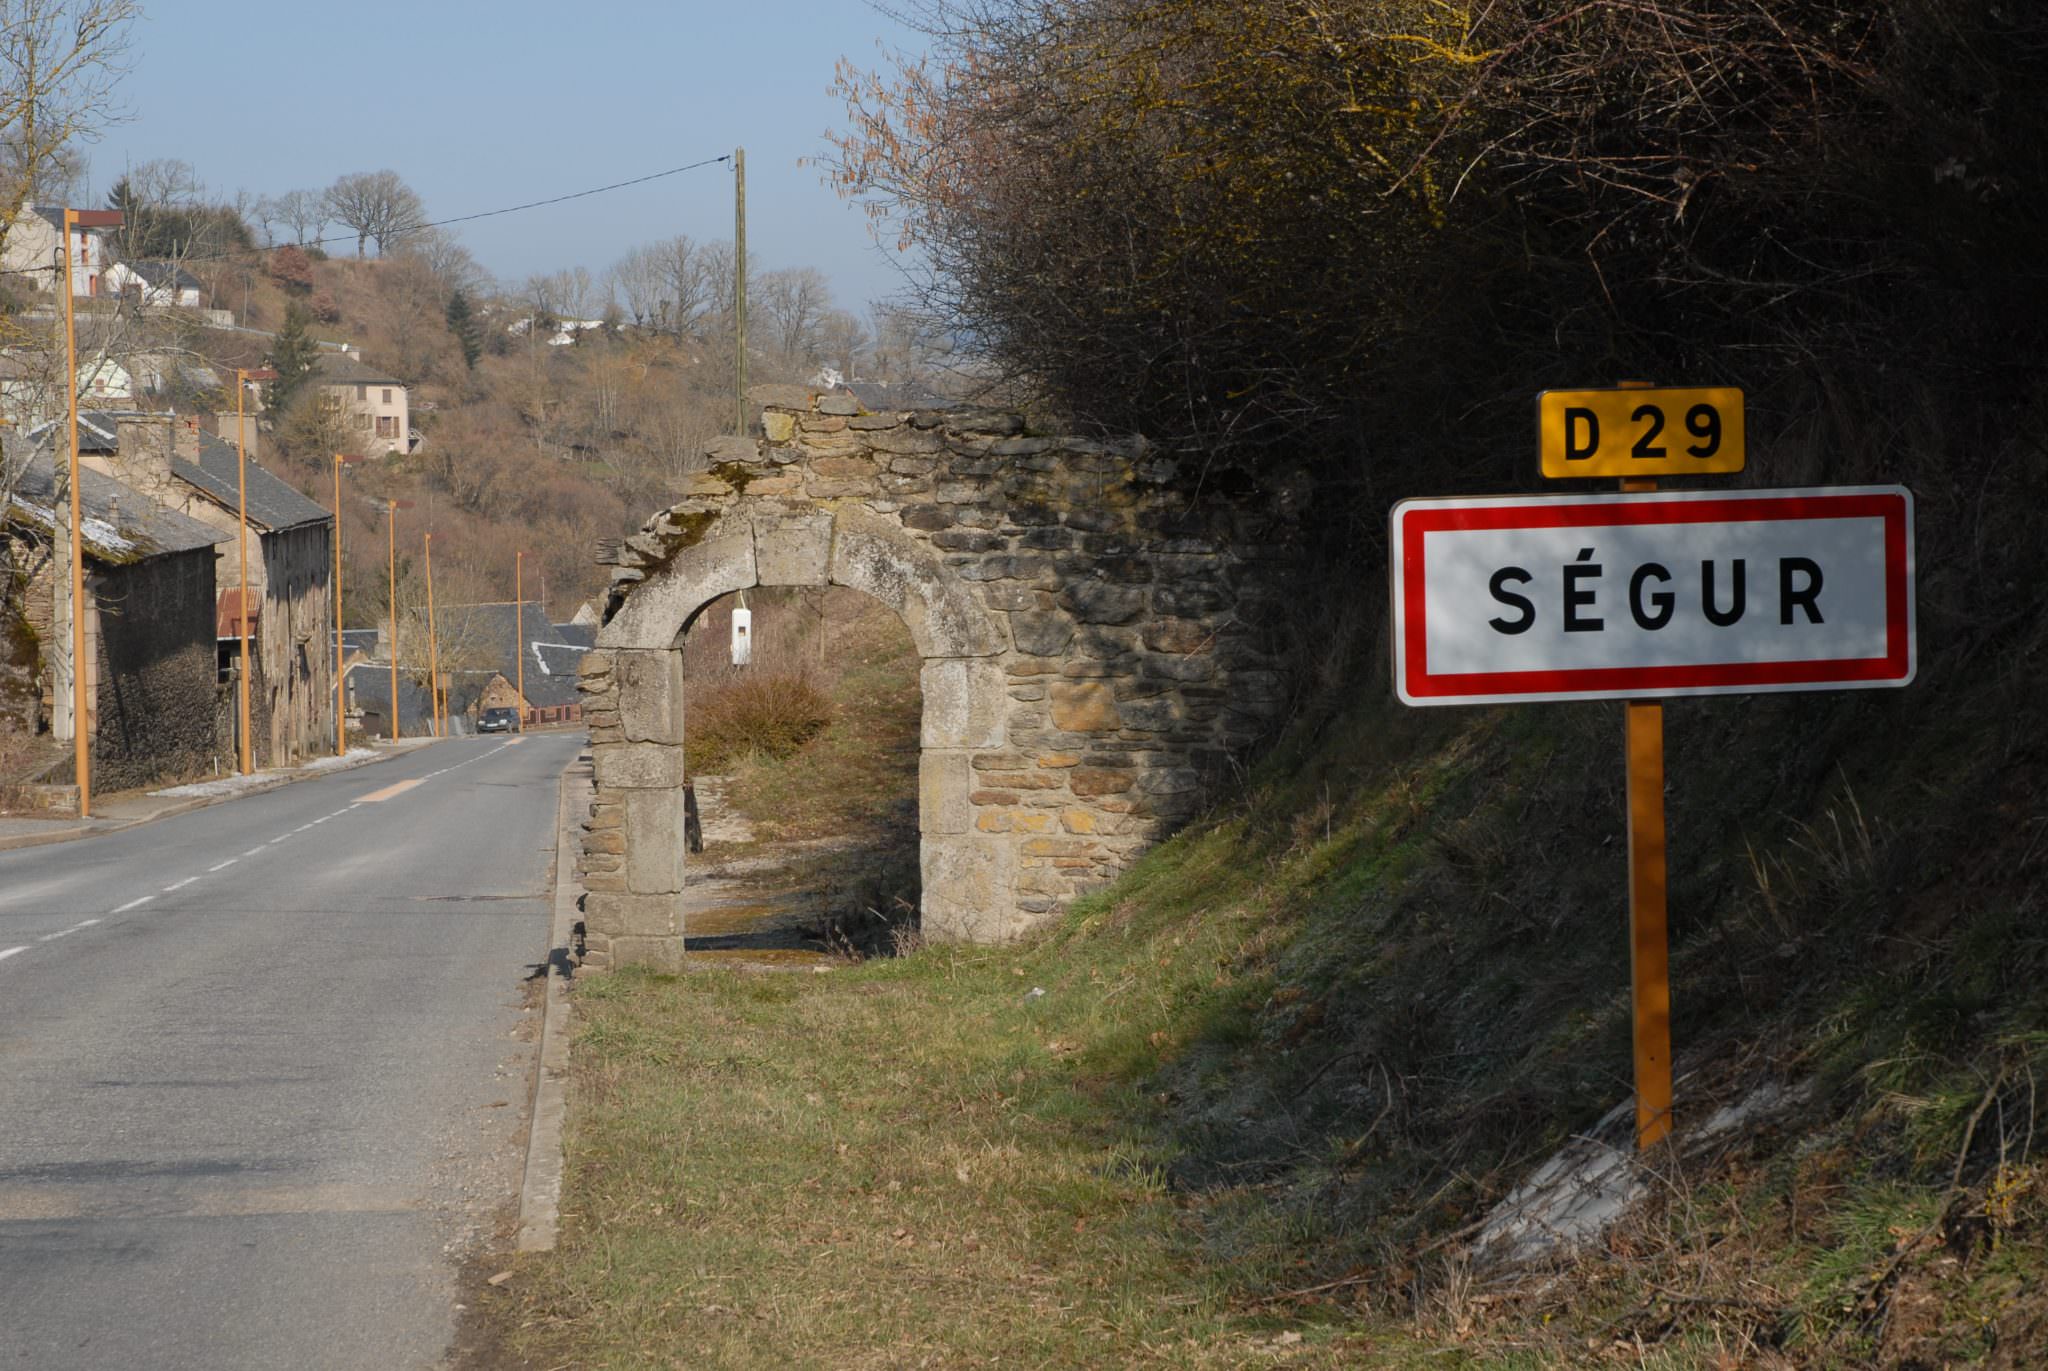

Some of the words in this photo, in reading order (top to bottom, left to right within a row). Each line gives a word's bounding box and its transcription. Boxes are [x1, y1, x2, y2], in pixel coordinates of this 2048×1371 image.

[1564, 407, 1601, 461] D
[1630, 403, 1722, 459] 29
[1488, 547, 1825, 635] SÉGUR
